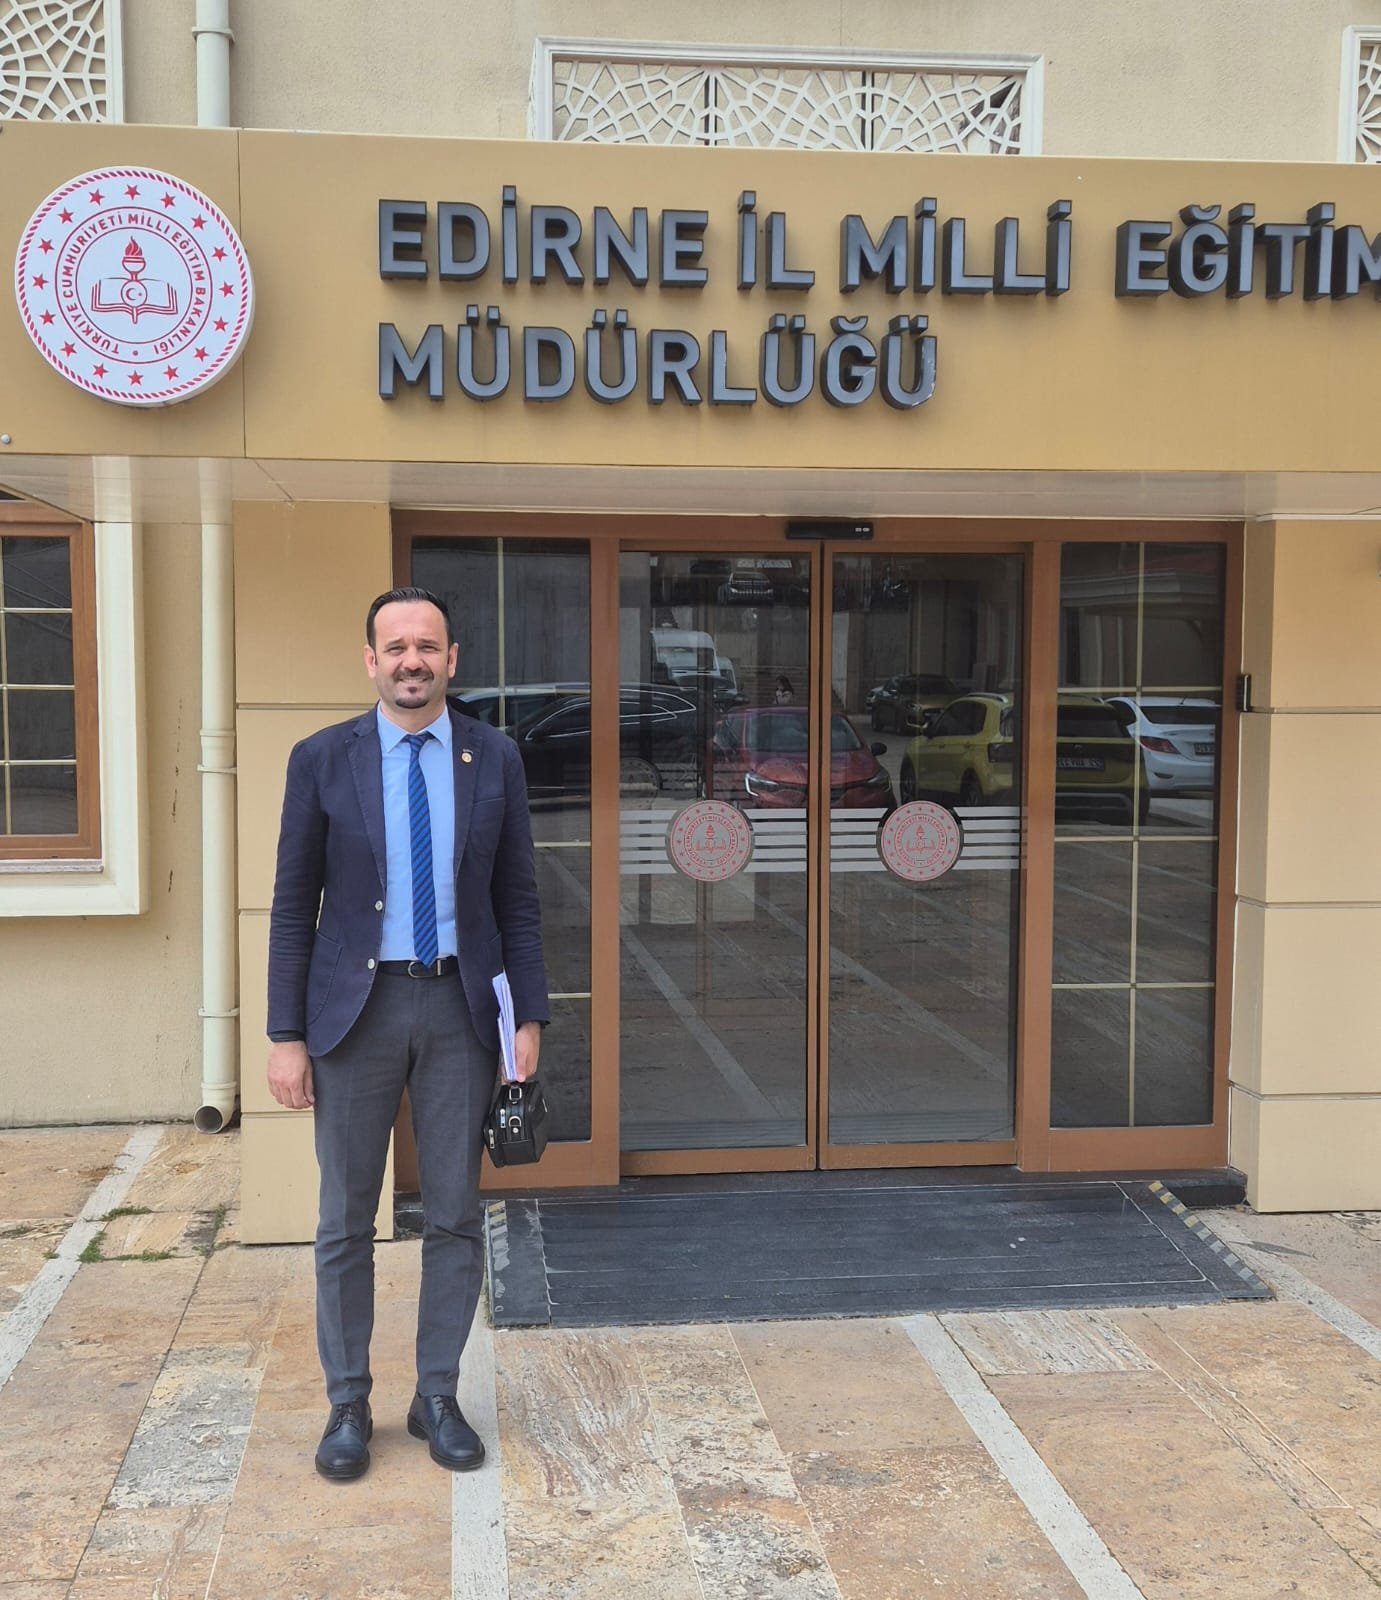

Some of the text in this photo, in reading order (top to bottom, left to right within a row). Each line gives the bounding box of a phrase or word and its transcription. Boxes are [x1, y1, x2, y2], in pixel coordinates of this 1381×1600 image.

[62, 211, 123, 298] CUMHURİYETİ
[171, 231, 205, 281] EĞİTİM
[379, 185, 1381, 301] EDİRNE İL MİLLİ EĞİTİM
[67, 302, 120, 354] TÜRKİYE
[154, 287, 206, 355] BAKANLIĞI
[379, 304, 937, 410] MÜDÜRLÜĞÜ
